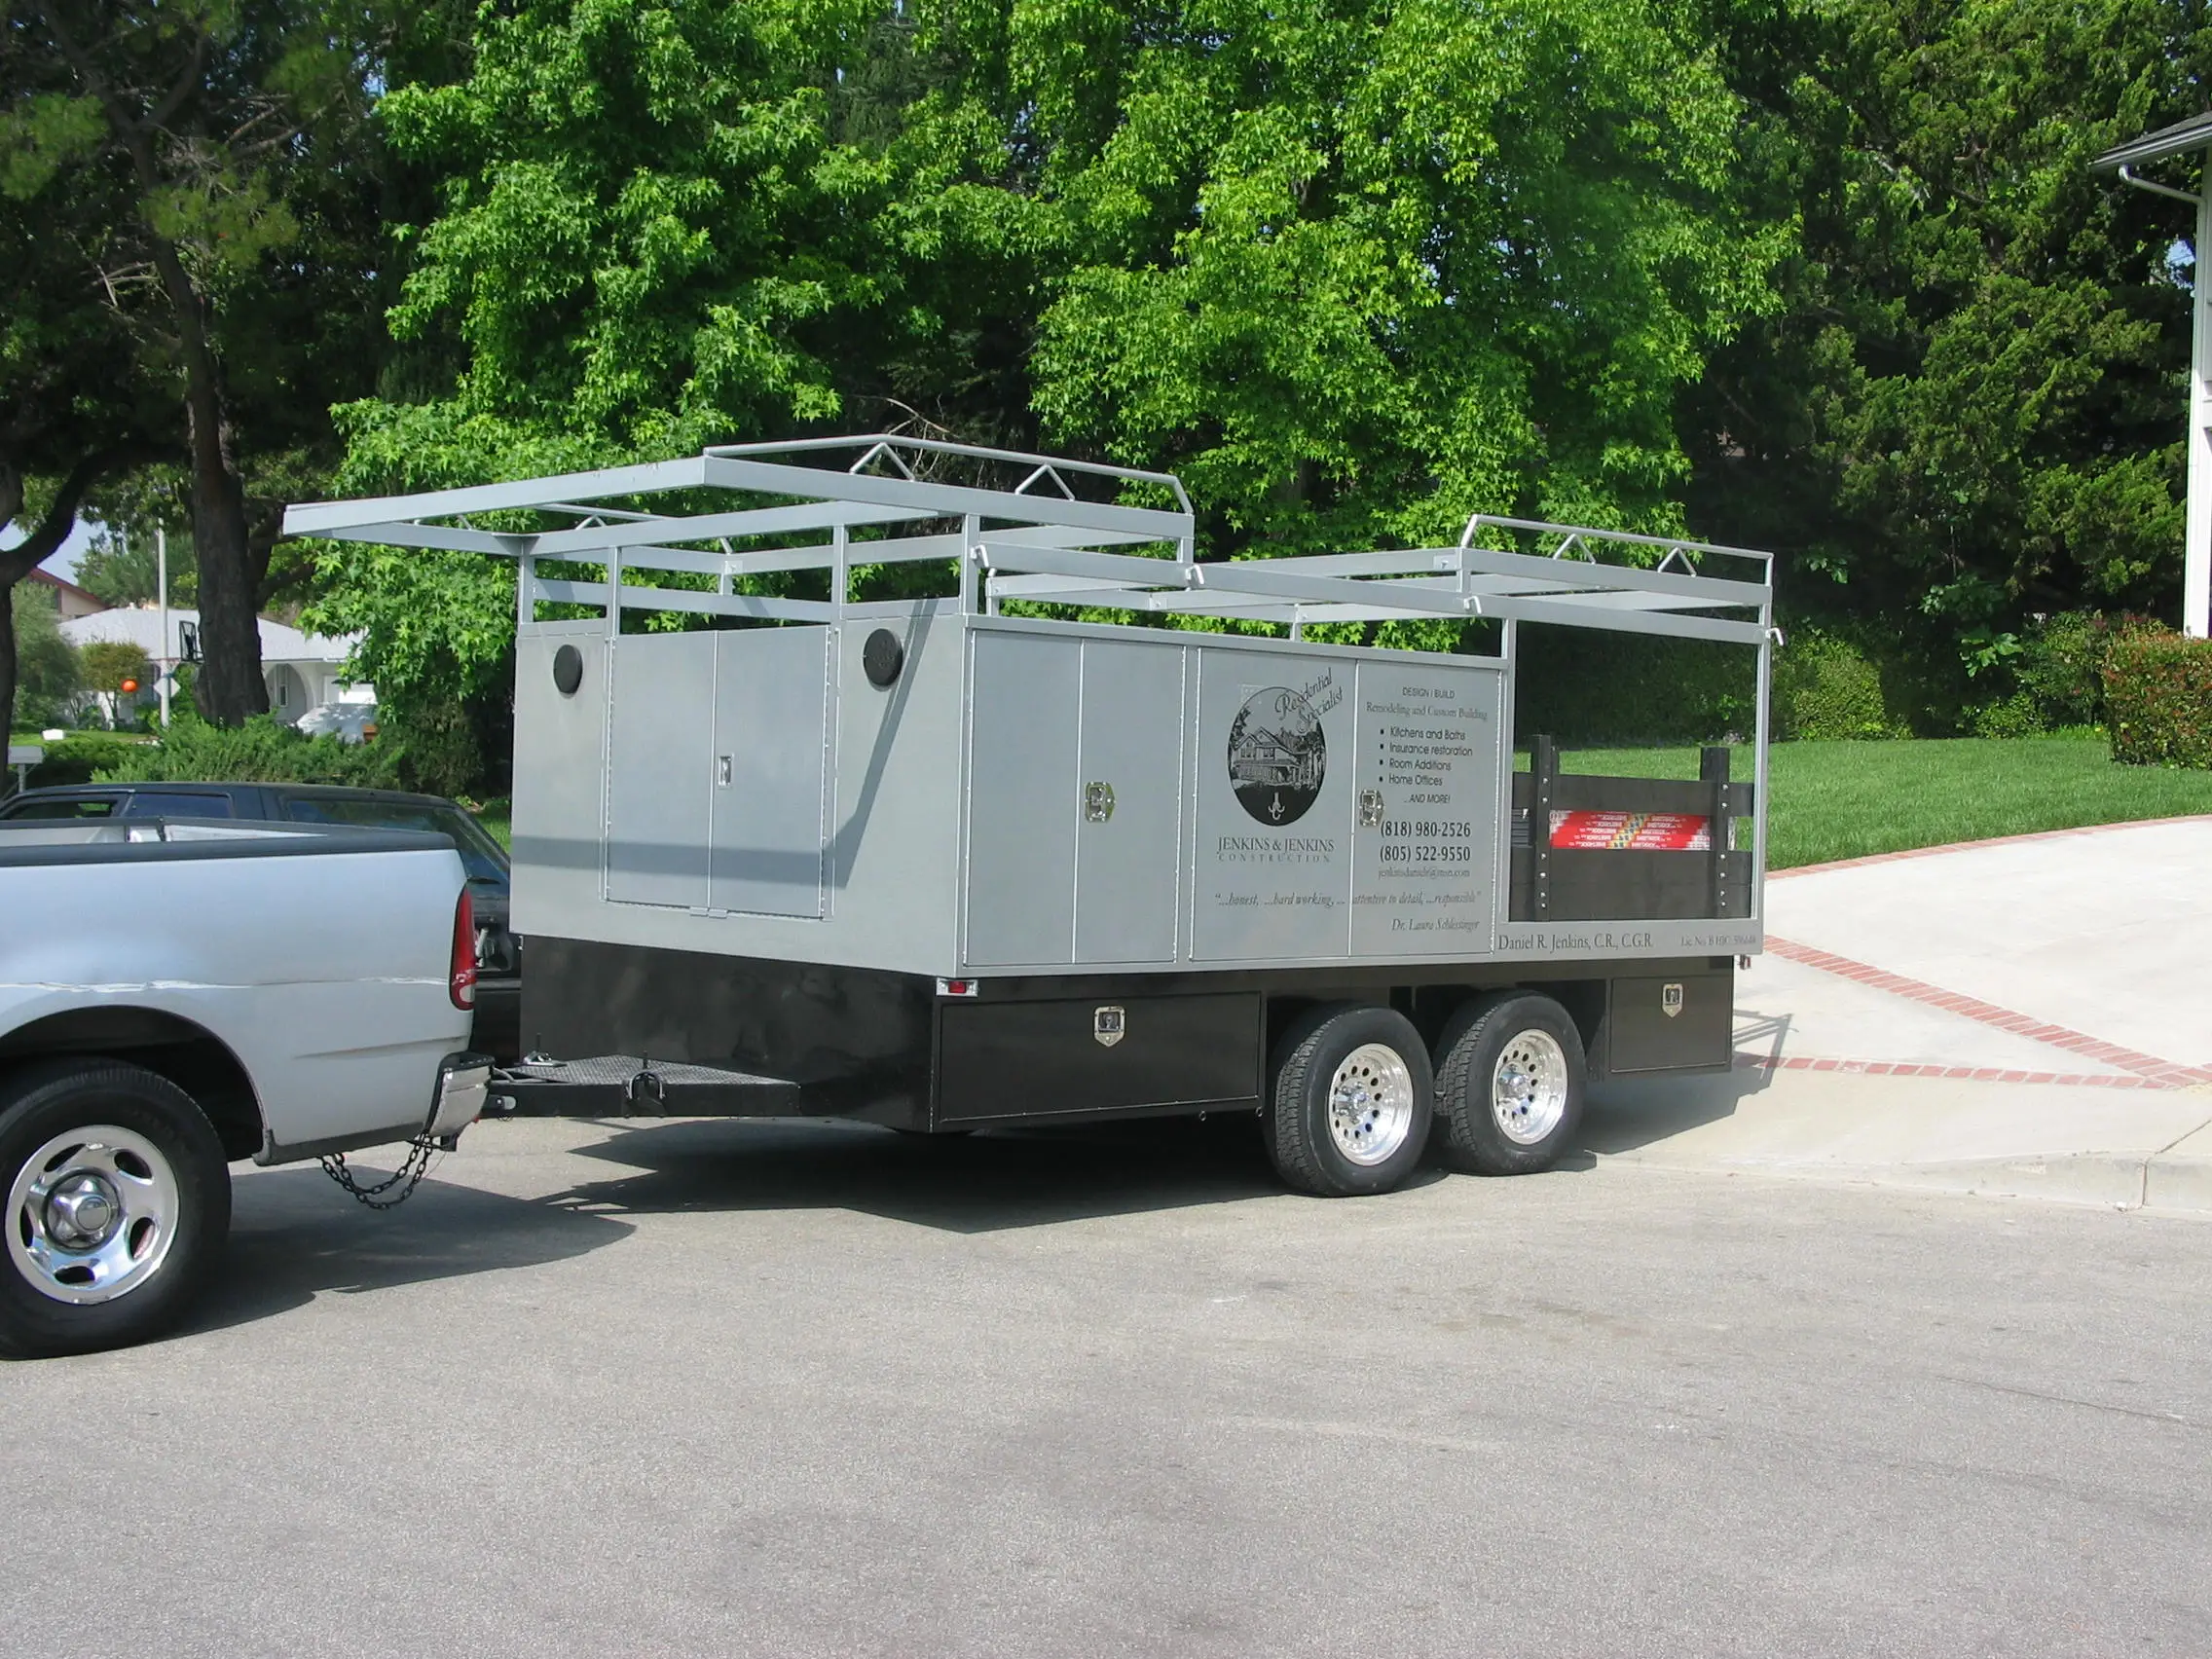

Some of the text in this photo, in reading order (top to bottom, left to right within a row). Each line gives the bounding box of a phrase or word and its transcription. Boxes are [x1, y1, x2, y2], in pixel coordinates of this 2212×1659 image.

[1274, 667, 1333, 720] Residential
[1402, 686, 1429, 698] DESIGN
[1434, 688, 1456, 699] BUILD
[1296, 686, 1344, 734] Specialist
[1366, 701, 1411, 719] Remodeling
[1389, 726, 1466, 741] Kitchens and Baths
[1389, 743, 1473, 756] Insurance restoration
[1389, 757, 1452, 771] Room Additions
[1388, 773, 1443, 787] Home Offices
[1380, 820, 1471, 838] (818) 980-2526
[1217, 836, 1335, 854] JENKINS & JENKINS
[1380, 845, 1471, 863] (805) 522-9550
[1218, 852, 1331, 863] CONSTRUCTION
[1498, 934, 1533, 950] Daniel
[1550, 934, 1592, 954] Jenkins,
